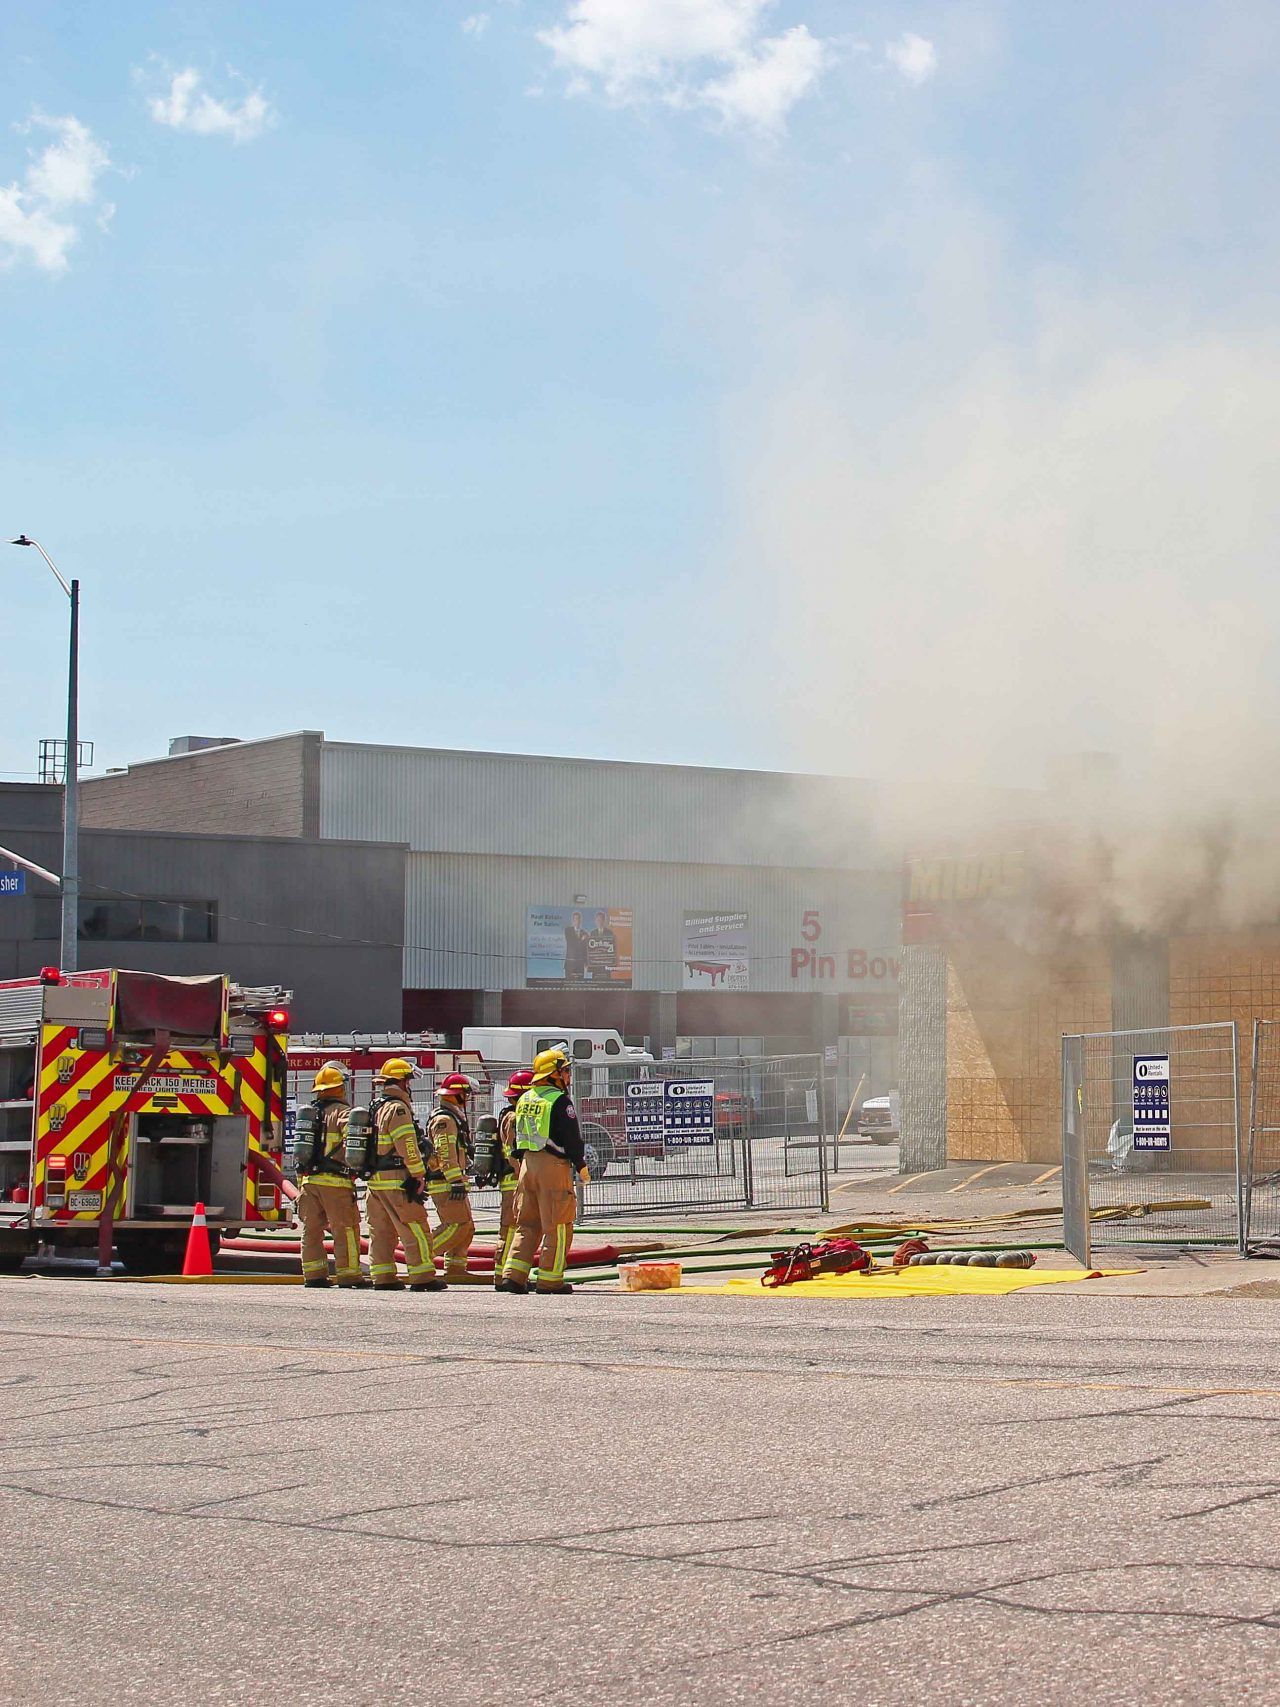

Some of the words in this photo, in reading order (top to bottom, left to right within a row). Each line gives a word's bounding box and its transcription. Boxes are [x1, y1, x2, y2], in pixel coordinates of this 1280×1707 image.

[0, 875, 19, 891] sher
[714, 913, 748, 923] Supplies
[715, 922, 744, 931] Service
[800, 910, 822, 942] 5
[791, 948, 836, 978] Pin
[115, 1076, 137, 1086] KEEP
[143, 1077, 162, 1087] ACK
[165, 1078, 180, 1087] 150
[182, 1079, 216, 1089] METRES
